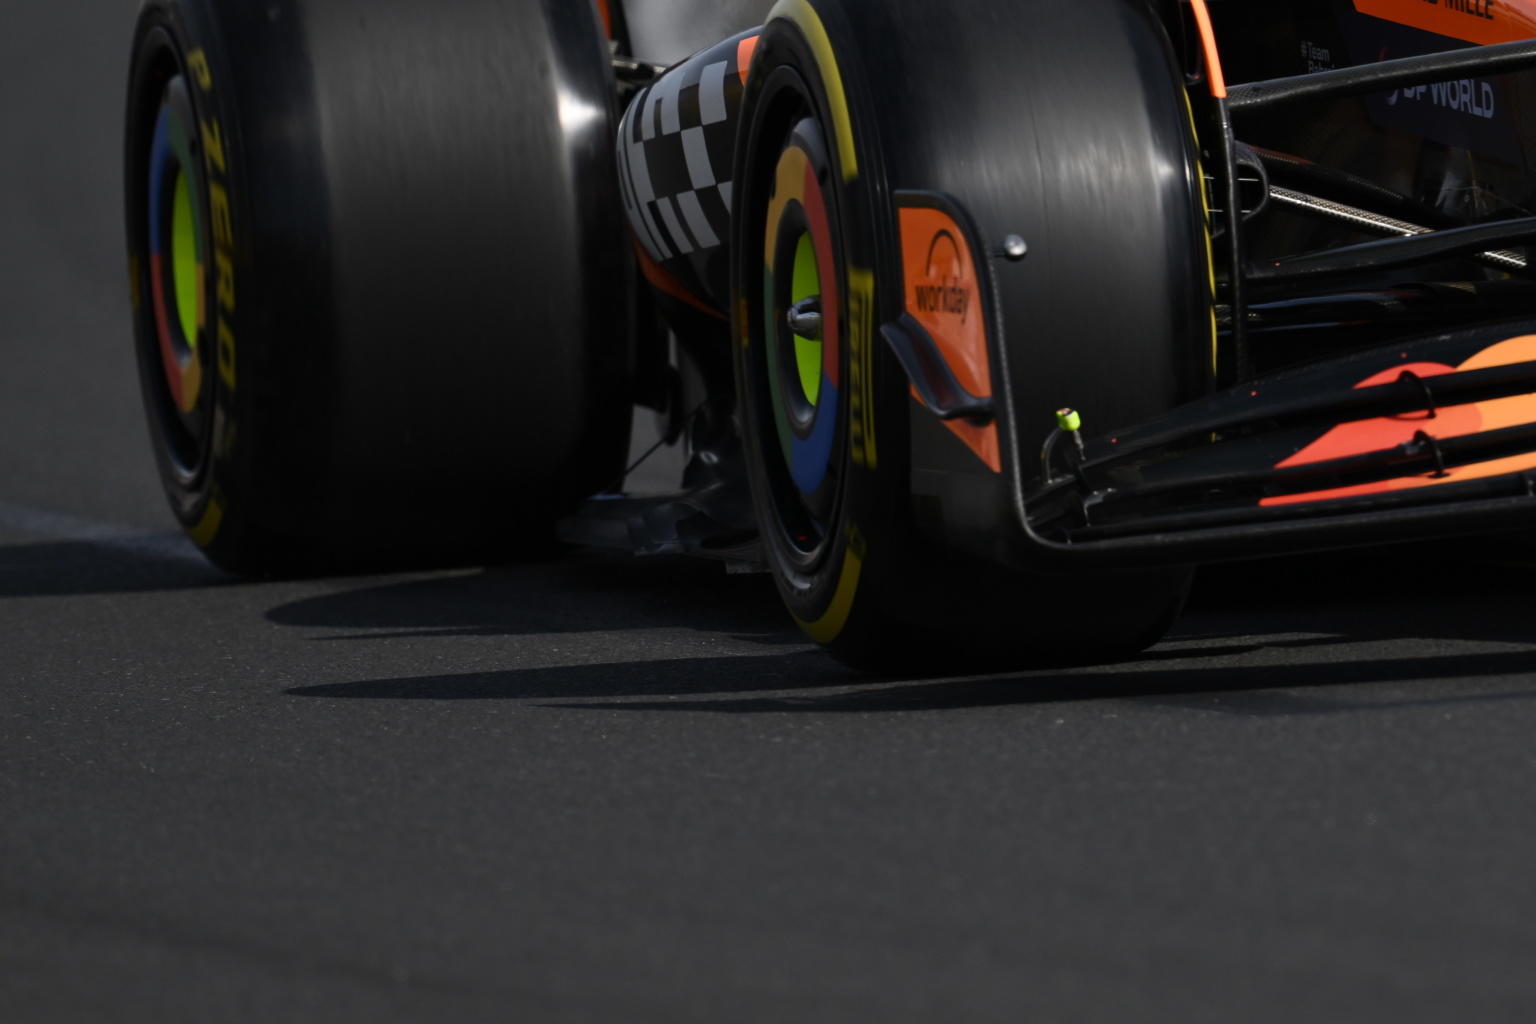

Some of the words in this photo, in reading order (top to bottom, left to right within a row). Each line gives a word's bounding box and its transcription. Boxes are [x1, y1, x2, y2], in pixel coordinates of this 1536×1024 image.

[1430, 78, 1495, 119] WORLD
[200, 116, 238, 393] ZERO
[915, 275, 970, 326] workday
